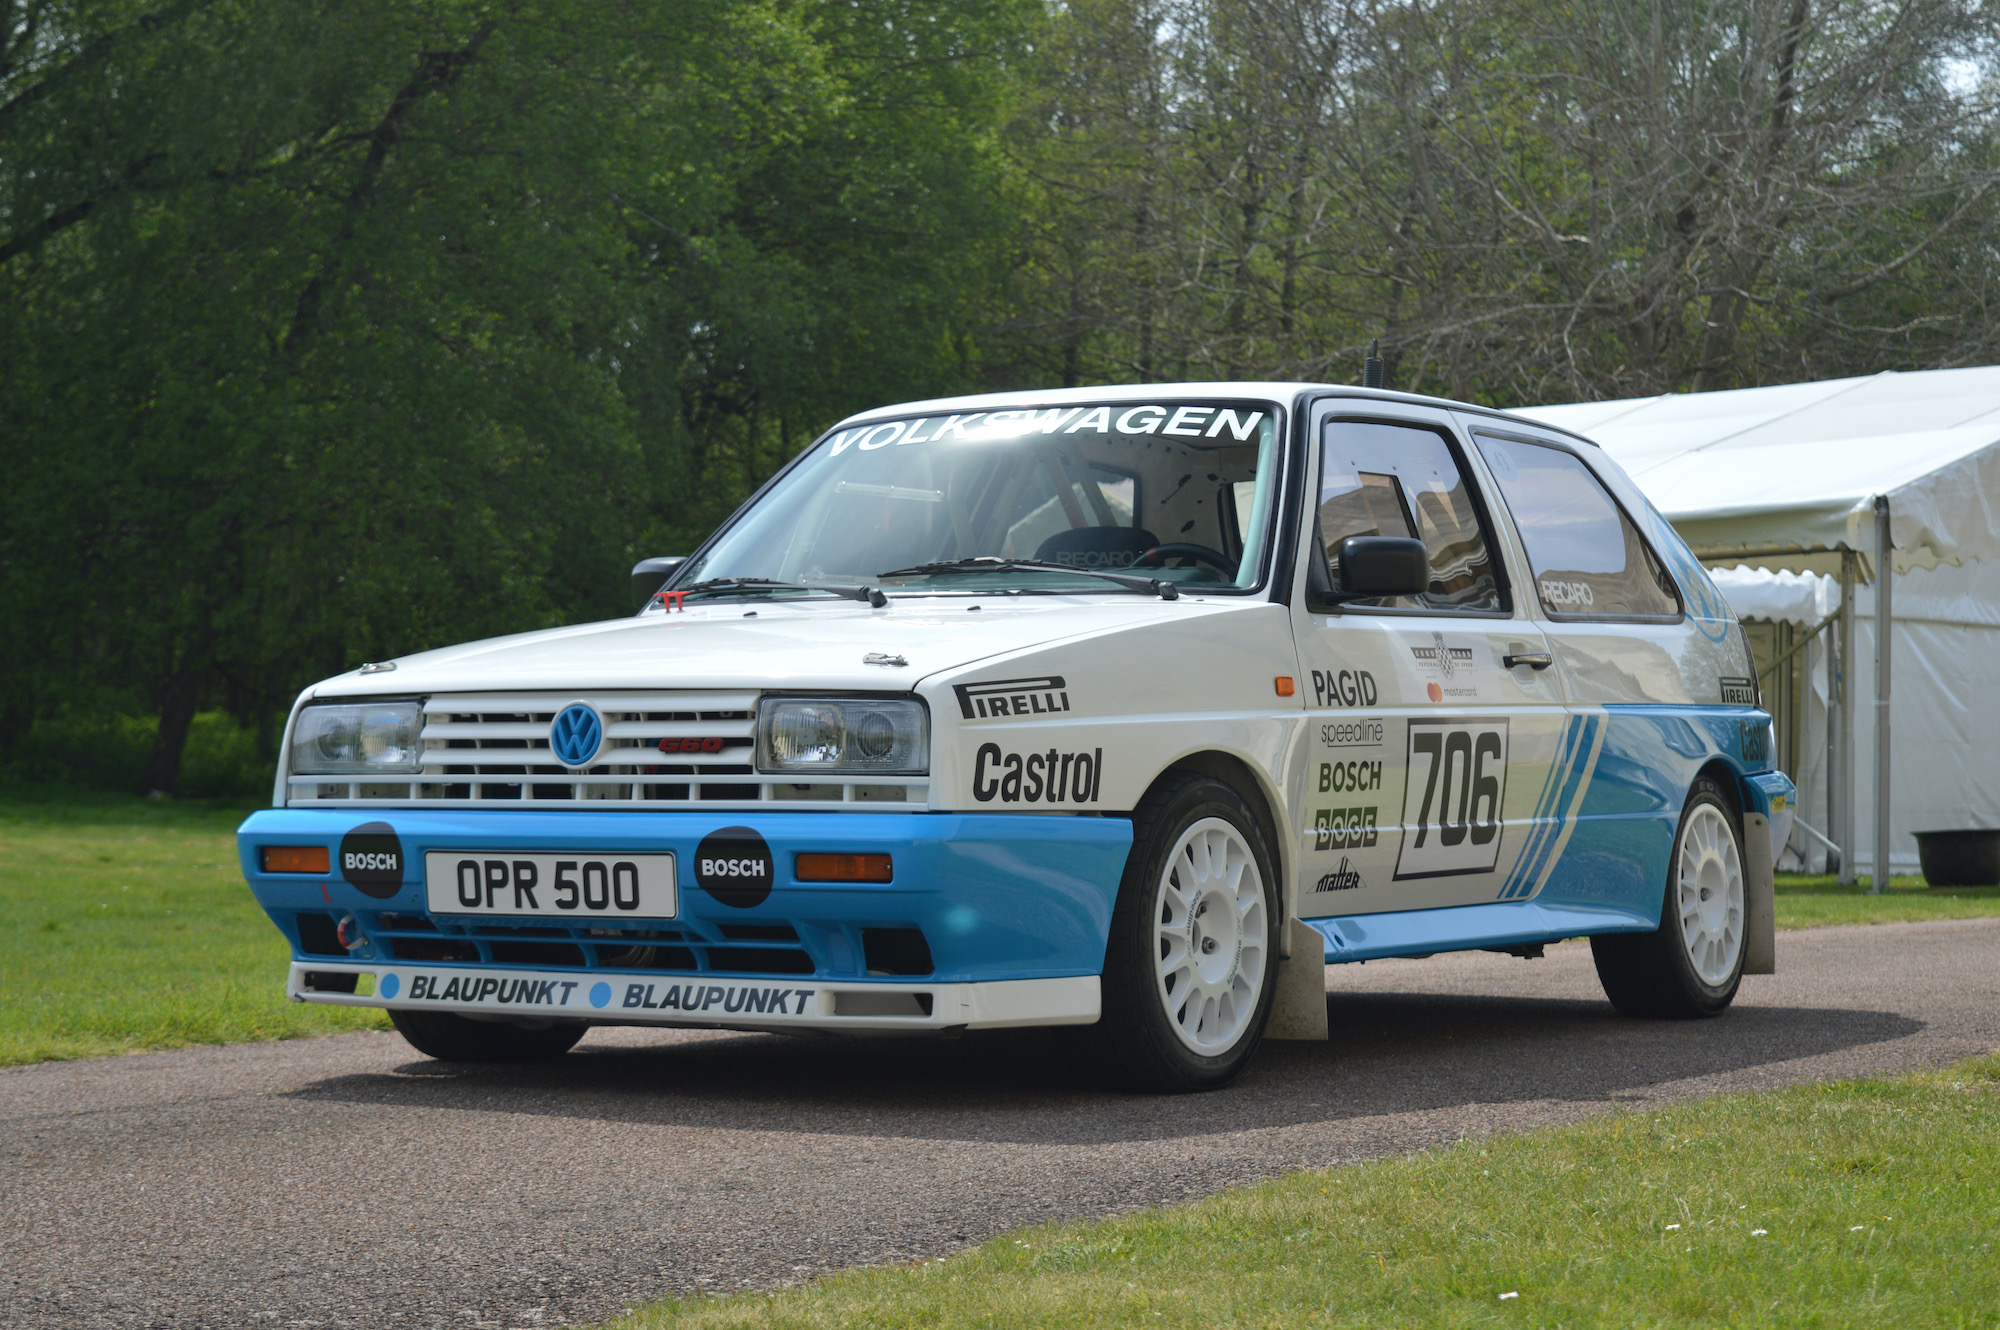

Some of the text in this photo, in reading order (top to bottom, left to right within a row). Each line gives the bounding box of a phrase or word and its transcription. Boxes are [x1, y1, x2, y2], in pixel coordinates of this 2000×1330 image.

[829, 405, 1264, 458] VOLKSWAGEN
[1056, 550, 1135, 567] RECARO
[1540, 579, 1595, 606] RECARO
[952, 675, 1070, 719] PIRELLI
[1311, 669, 1378, 707] PAGID
[1443, 686, 1478, 697] mastercard
[1718, 676, 1755, 703] PIRELLI
[552, 704, 602, 765] VW
[658, 737, 723, 752] G60
[1321, 718, 1383, 747] speedline
[1740, 719, 1774, 761] Castr
[973, 742, 1103, 803] Castrol
[1318, 760, 1383, 793] BOSCH
[1413, 731, 1502, 849] 706
[1316, 813, 1377, 844] BOGE
[344, 852, 398, 871] BOSCH
[701, 858, 766, 877] BOSCH
[457, 859, 640, 910] OPR 500
[409, 975, 580, 1006] BLAUPUNKT
[622, 982, 815, 1015] BLAUPUNKT
